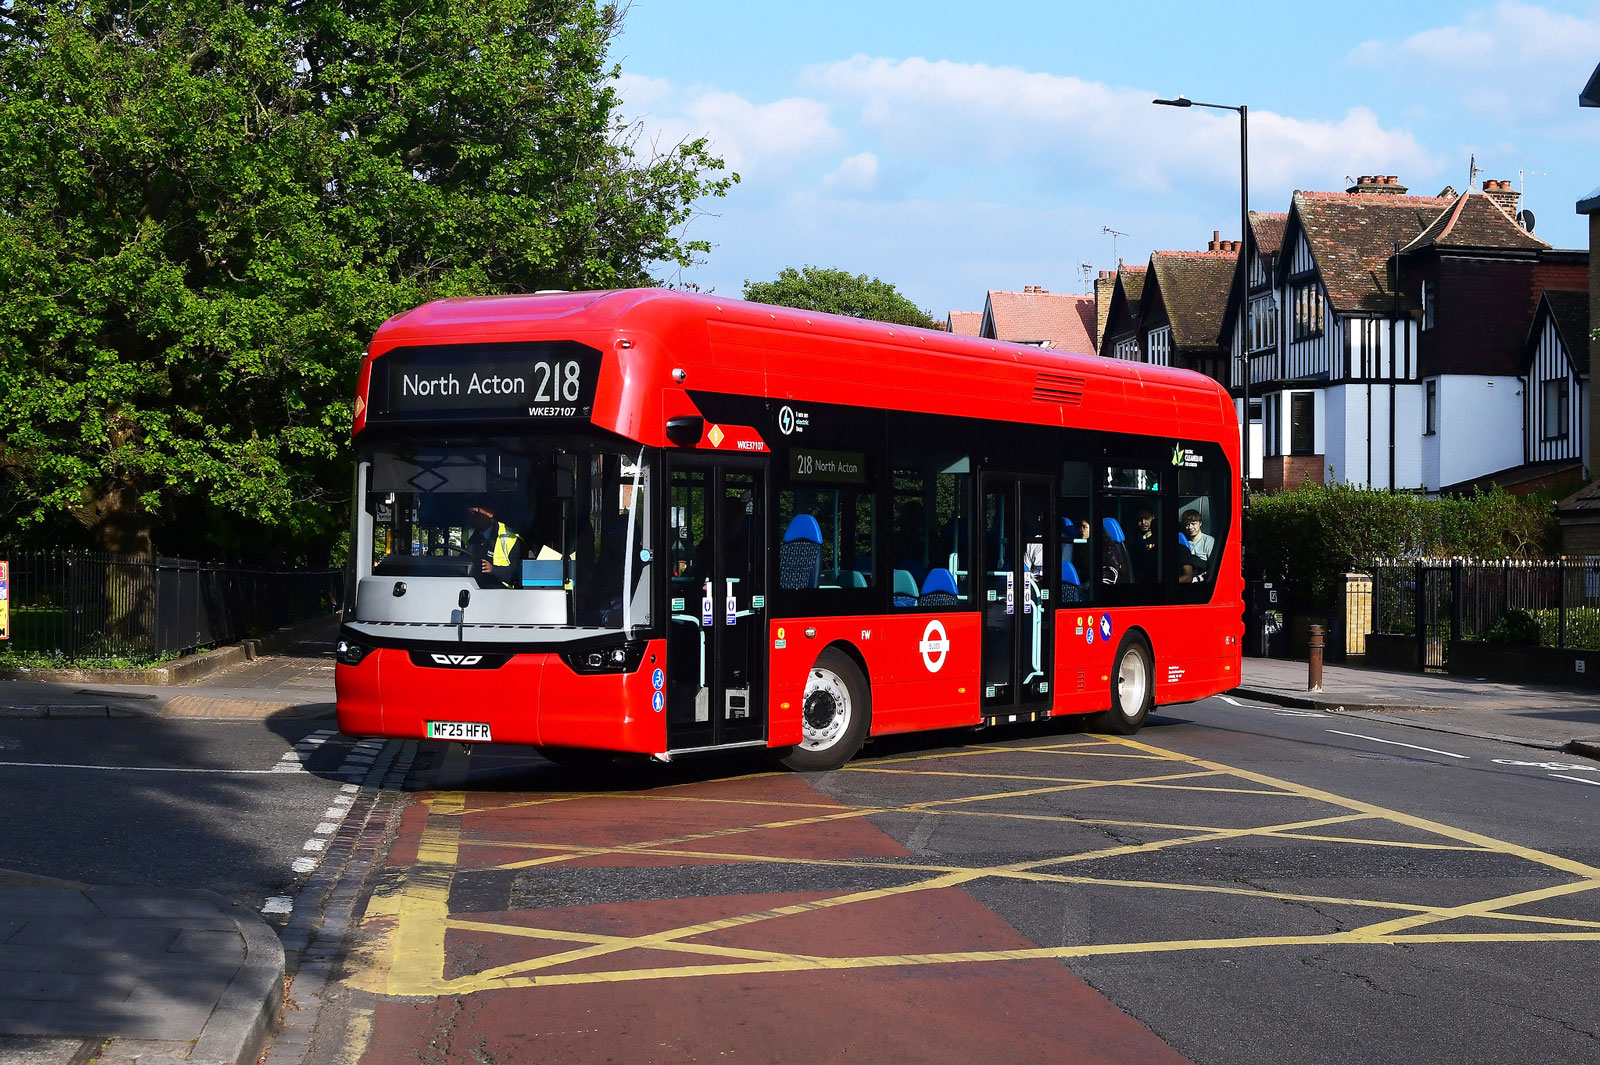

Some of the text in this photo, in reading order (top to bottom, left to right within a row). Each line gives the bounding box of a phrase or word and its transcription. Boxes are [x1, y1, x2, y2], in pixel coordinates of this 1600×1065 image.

[403, 360, 581, 402] North Acton 218
[528, 407, 577, 416] WKE37107
[736, 440, 764, 450] WKE37107
[797, 454, 858, 474] 218 North Acton
[861, 629, 871, 640] FW
[434, 723, 489, 738] MF25 HFR
